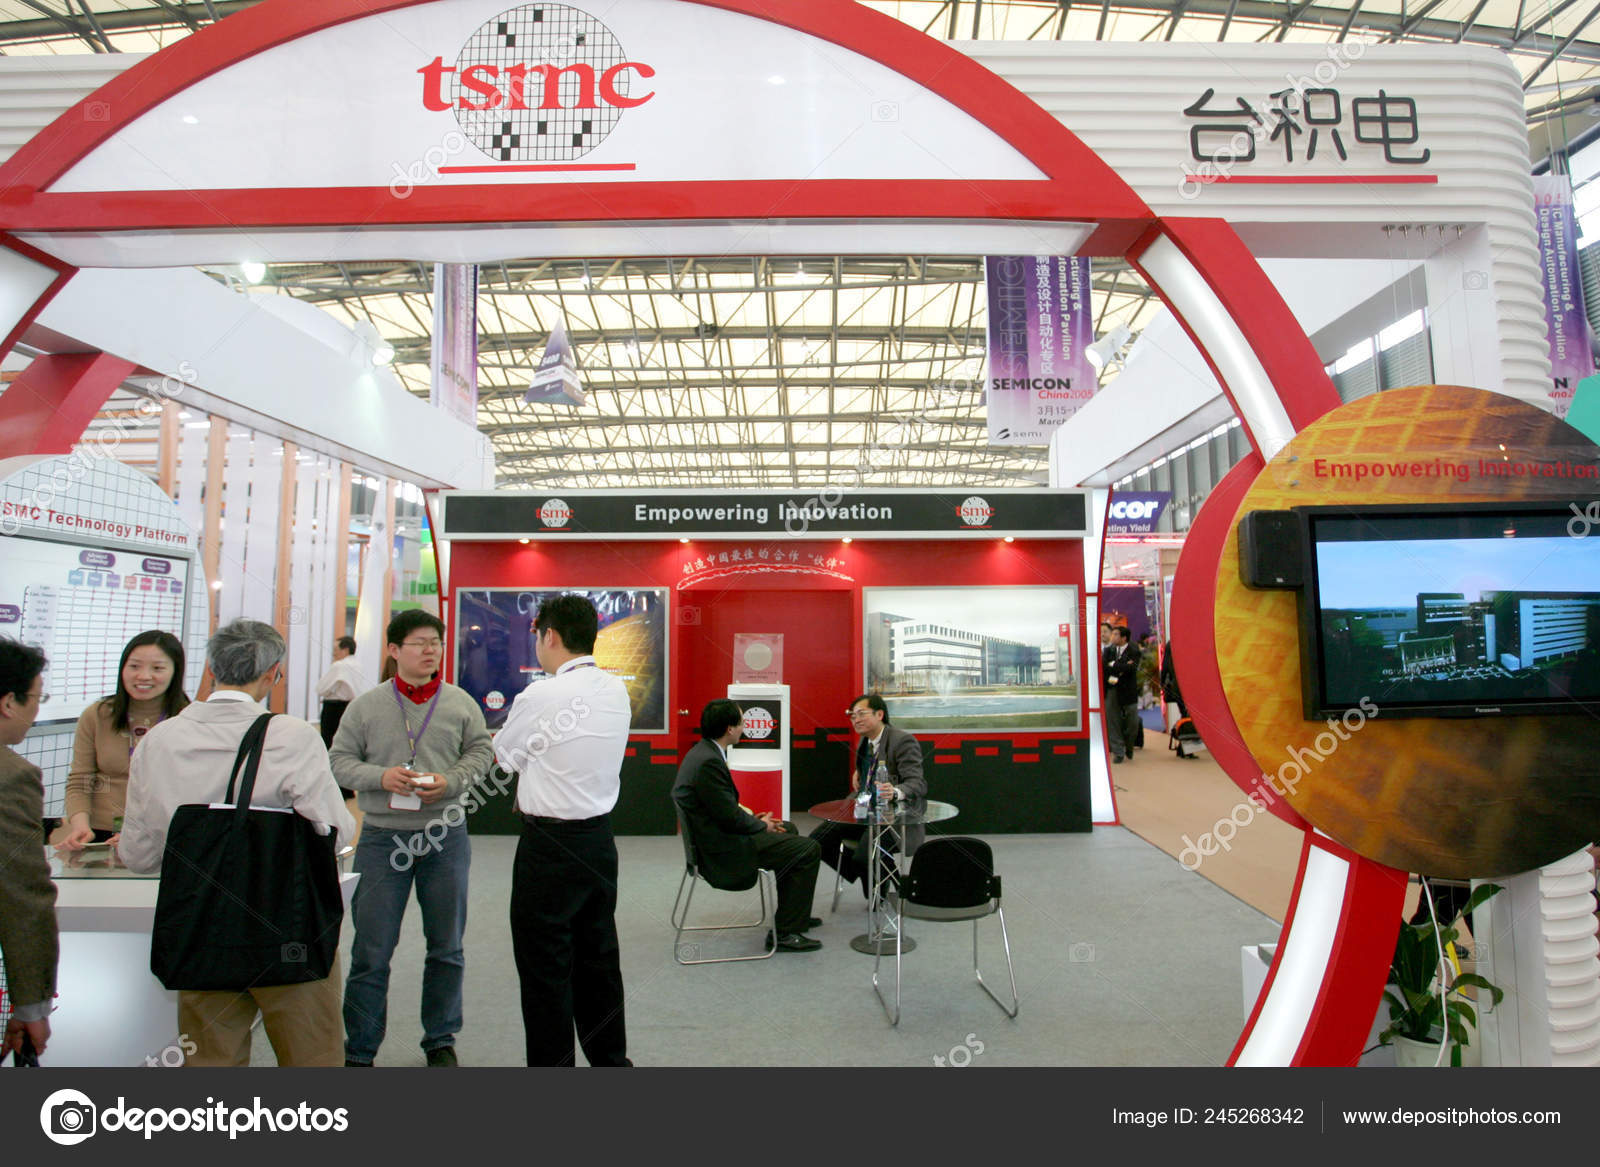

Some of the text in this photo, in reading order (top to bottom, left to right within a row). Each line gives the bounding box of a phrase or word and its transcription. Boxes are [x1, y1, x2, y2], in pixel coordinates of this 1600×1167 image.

[417, 56, 656, 111] tsmc
[1184, 88, 1431, 163] 台积电
[1540, 208, 1551, 246] Design
[1544, 248, 1561, 312] Automation
[1553, 221, 1571, 301] Manufacturing
[997, 256, 1027, 373] SEMIC
[1073, 302, 1082, 311] &
[1061, 313, 1073, 361] Pavilion
[1552, 314, 1567, 361] Pavilion
[992, 378, 1071, 390] SEMICON
[1313, 458, 1600, 481] Empowering Innovation
[2, 501, 188, 544] SMC Technology Platform
[535, 507, 575, 519] tsmc
[635, 503, 893, 524] Empowering Innovation
[955, 505, 996, 517] tsmc
[1129, 524, 1151, 533] Yield
[743, 719, 778, 729] smc
